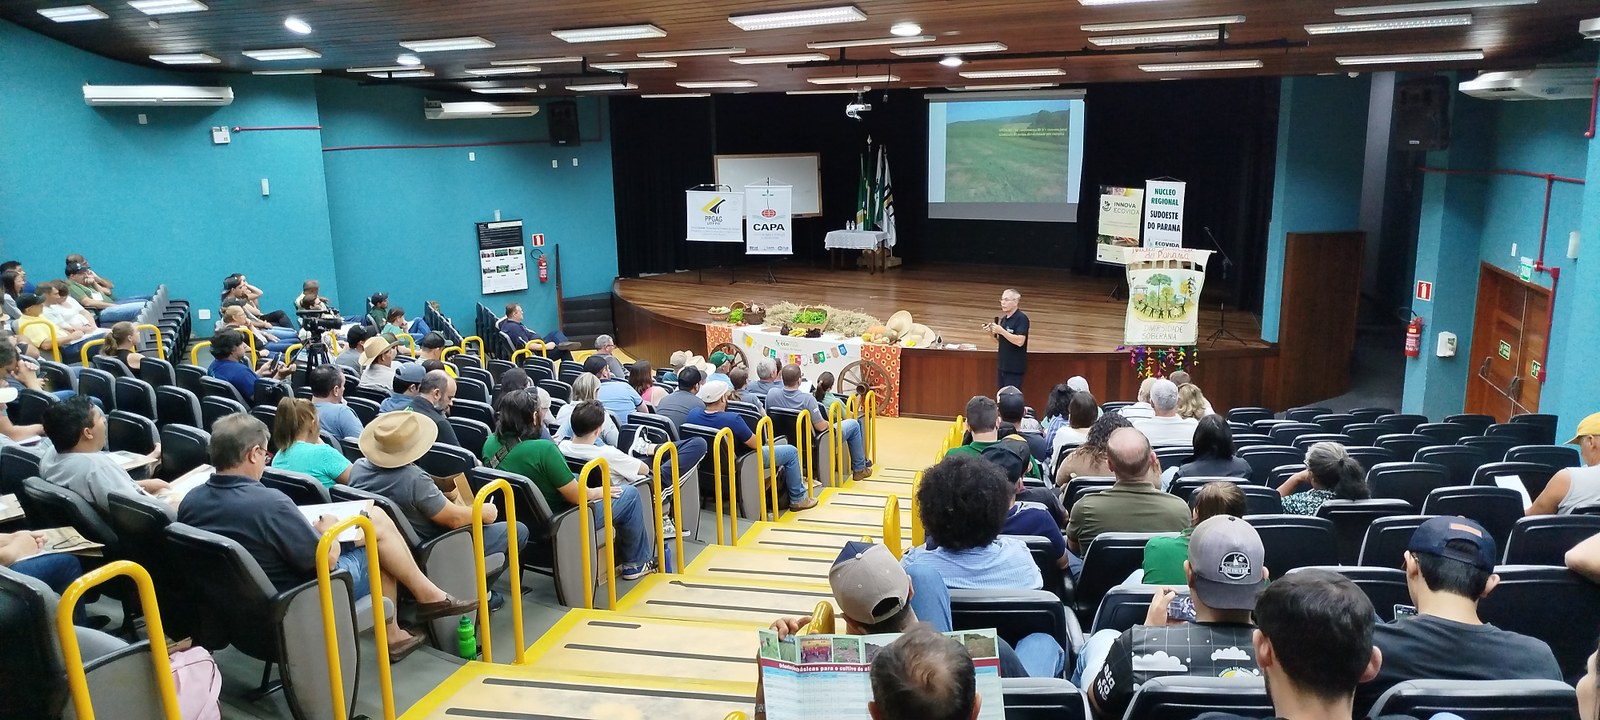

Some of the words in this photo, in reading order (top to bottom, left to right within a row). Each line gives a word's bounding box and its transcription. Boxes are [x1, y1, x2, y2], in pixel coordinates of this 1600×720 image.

[1154, 188, 1176, 196] NUCLEO
[1151, 197, 1179, 206] REGIONAL
[1150, 210, 1179, 220] SUDOESTE
[753, 223, 785, 231] CAPA
[1147, 222, 1156, 230] DO
[1156, 222, 1181, 232] PARANA
